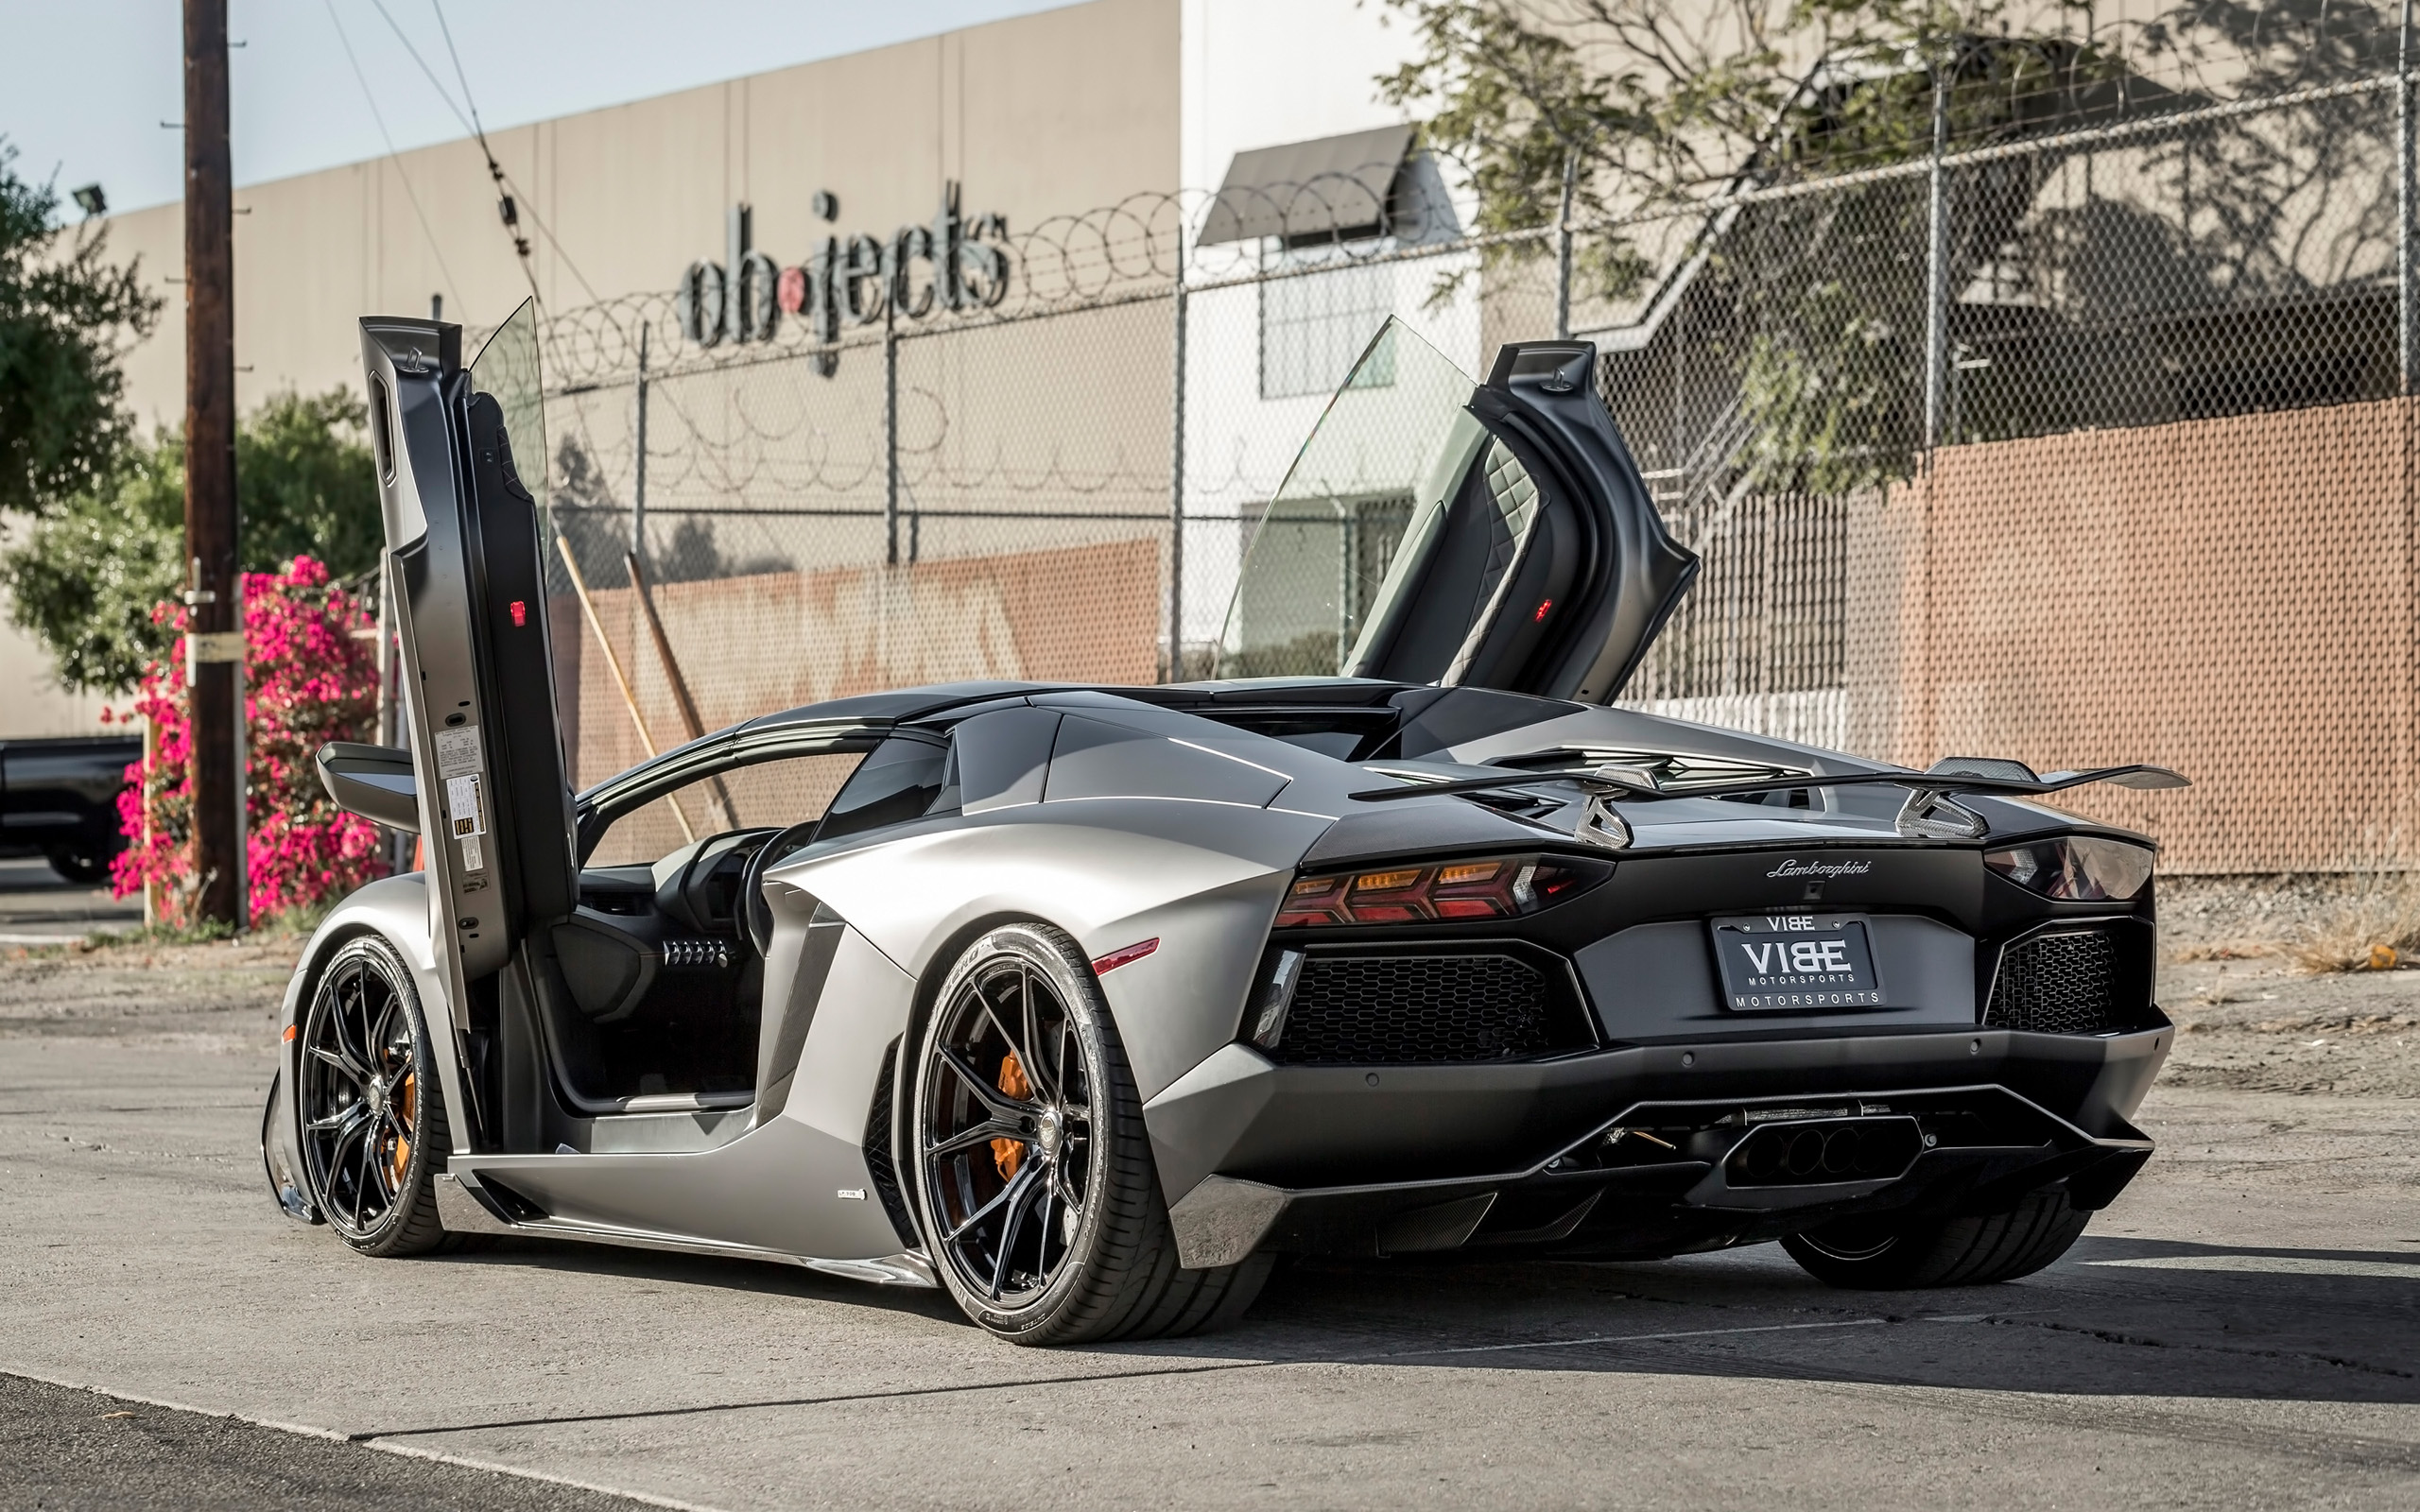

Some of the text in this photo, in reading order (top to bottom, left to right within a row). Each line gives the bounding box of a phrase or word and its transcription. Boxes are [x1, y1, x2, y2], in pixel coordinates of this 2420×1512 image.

[1766, 859, 1872, 878] Lamborghini
[1766, 916, 1816, 932] VIBE
[1741, 939, 1852, 974] VIBE
[1749, 973, 1855, 986] MOTORSPORTS
[1735, 992, 1879, 1007] MOTORSPORTS
